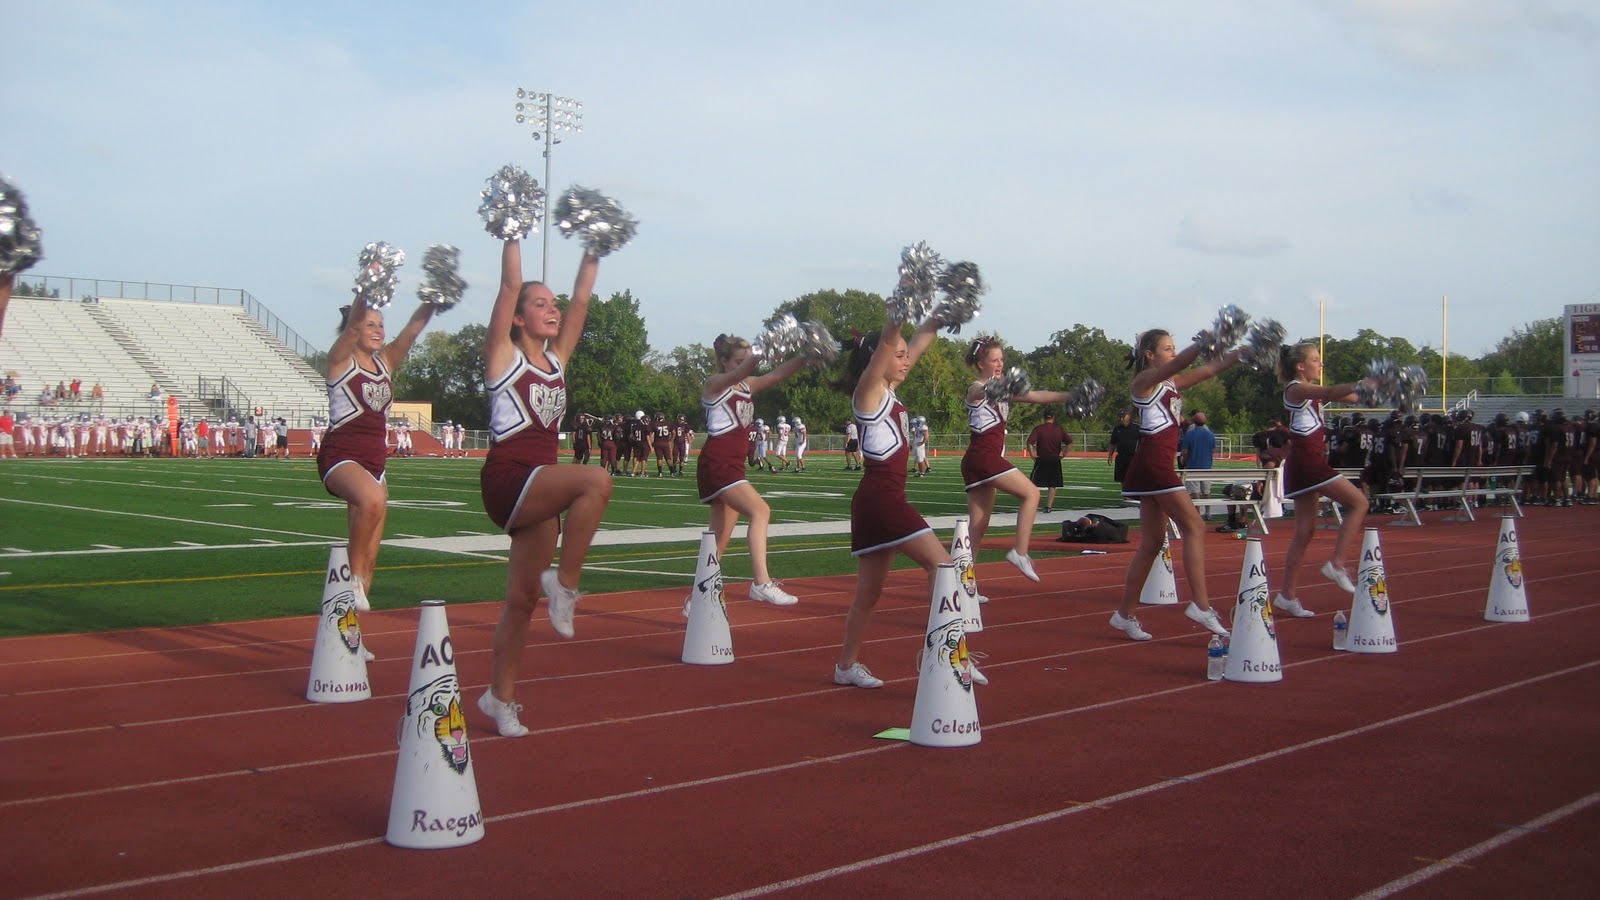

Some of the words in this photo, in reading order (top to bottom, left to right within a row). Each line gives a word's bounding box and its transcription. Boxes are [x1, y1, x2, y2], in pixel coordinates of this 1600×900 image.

[658, 425, 668, 437] 75
[1360, 433, 1373, 450] 65
[328, 564, 351, 584] AC
[420, 635, 454, 669] AC
[313, 679, 368, 693] Brianna
